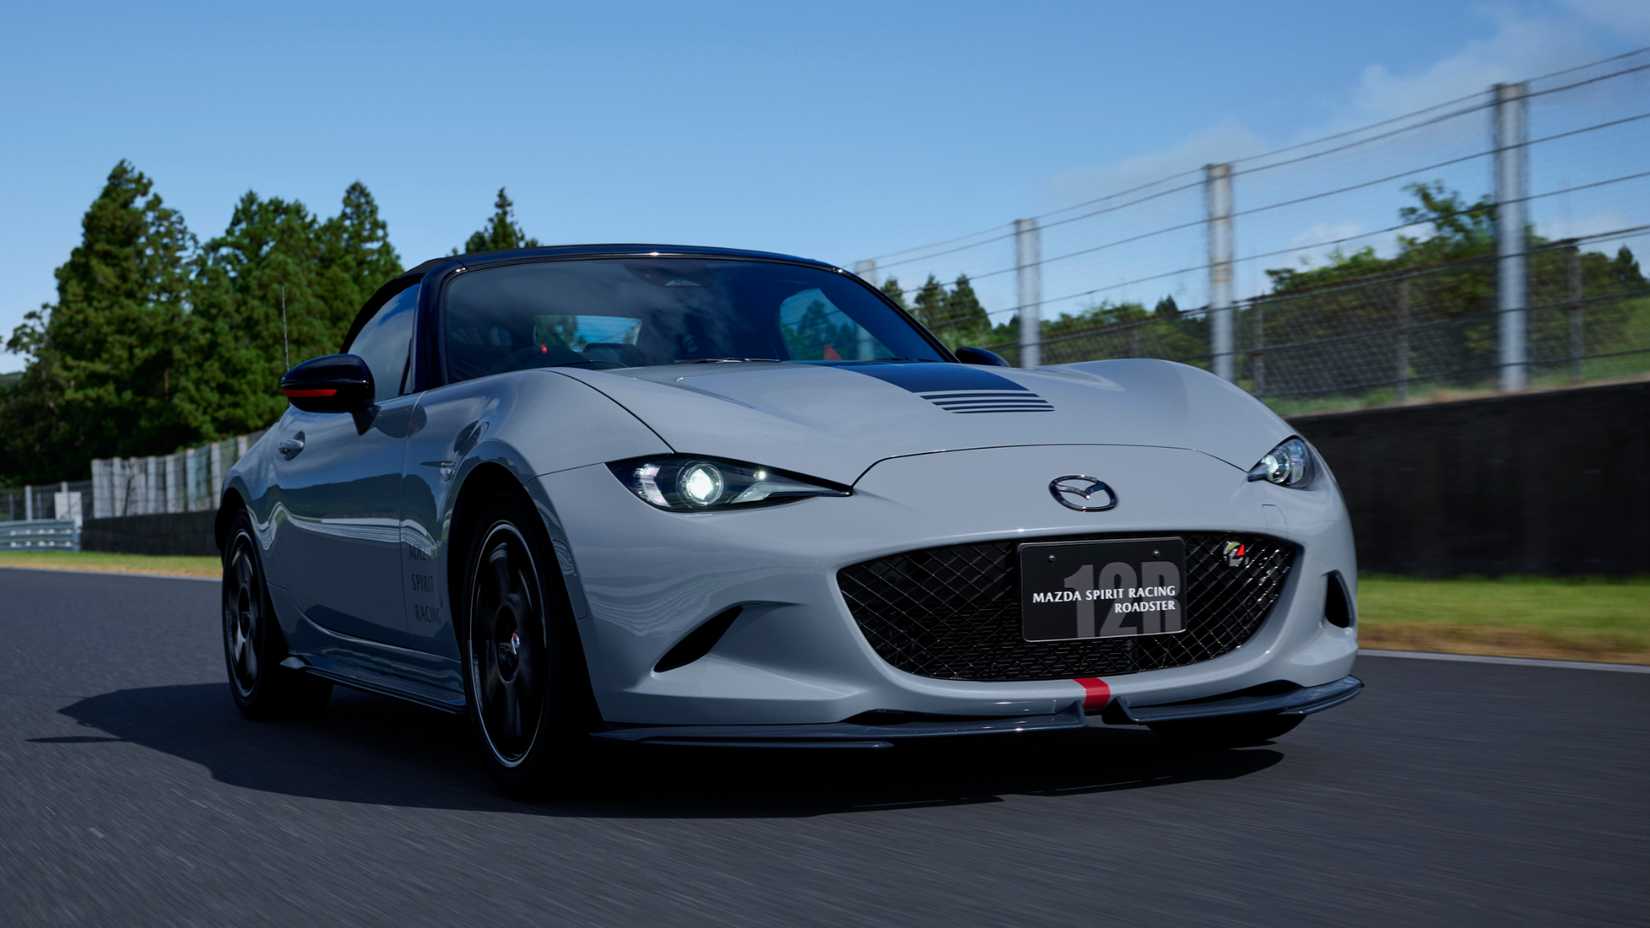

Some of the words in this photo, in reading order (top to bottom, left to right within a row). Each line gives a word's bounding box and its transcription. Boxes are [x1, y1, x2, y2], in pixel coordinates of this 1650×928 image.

[1032, 591, 1082, 603] MAZDA
[1085, 588, 1125, 600] SPIRIT
[1128, 585, 1176, 598] RACING
[1063, 561, 1182, 638] 12R
[1114, 600, 1176, 613] ROADSTER
